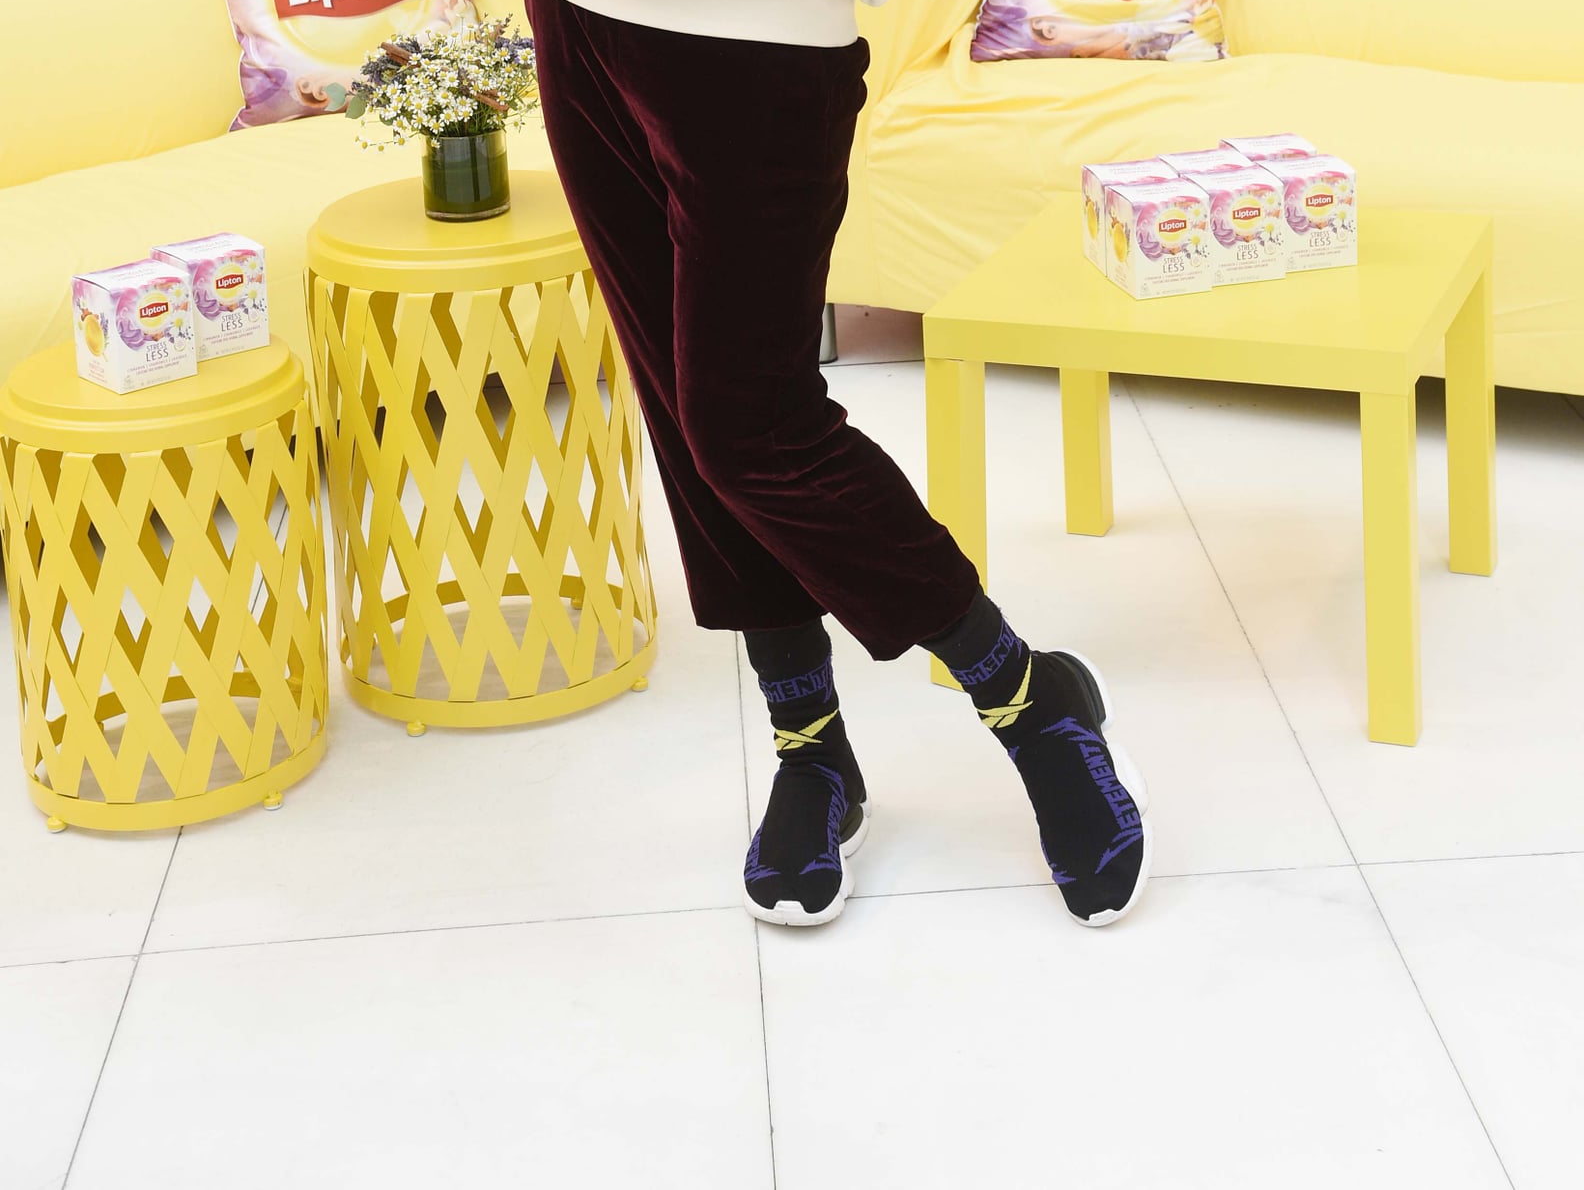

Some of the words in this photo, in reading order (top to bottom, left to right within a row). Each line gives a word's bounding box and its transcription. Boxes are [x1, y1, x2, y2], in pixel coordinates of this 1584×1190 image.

[1308, 196, 1332, 206] Lipton
[1235, 209, 1259, 219] Lipton
[1160, 220, 1185, 231] Lipton
[1237, 243, 1257, 251] STRESS
[1309, 237, 1331, 247] LESS
[1163, 256, 1184, 264] STRESS
[1236, 250, 1259, 261] LESS
[1162, 263, 1185, 274] LESS
[218, 276, 242, 288] Lipton
[141, 303, 167, 317] Lipton
[221, 313, 242, 323] STRESS
[221, 320, 244, 332] LESS
[146, 341, 167, 353] STRESS
[145, 349, 169, 362] LESS
